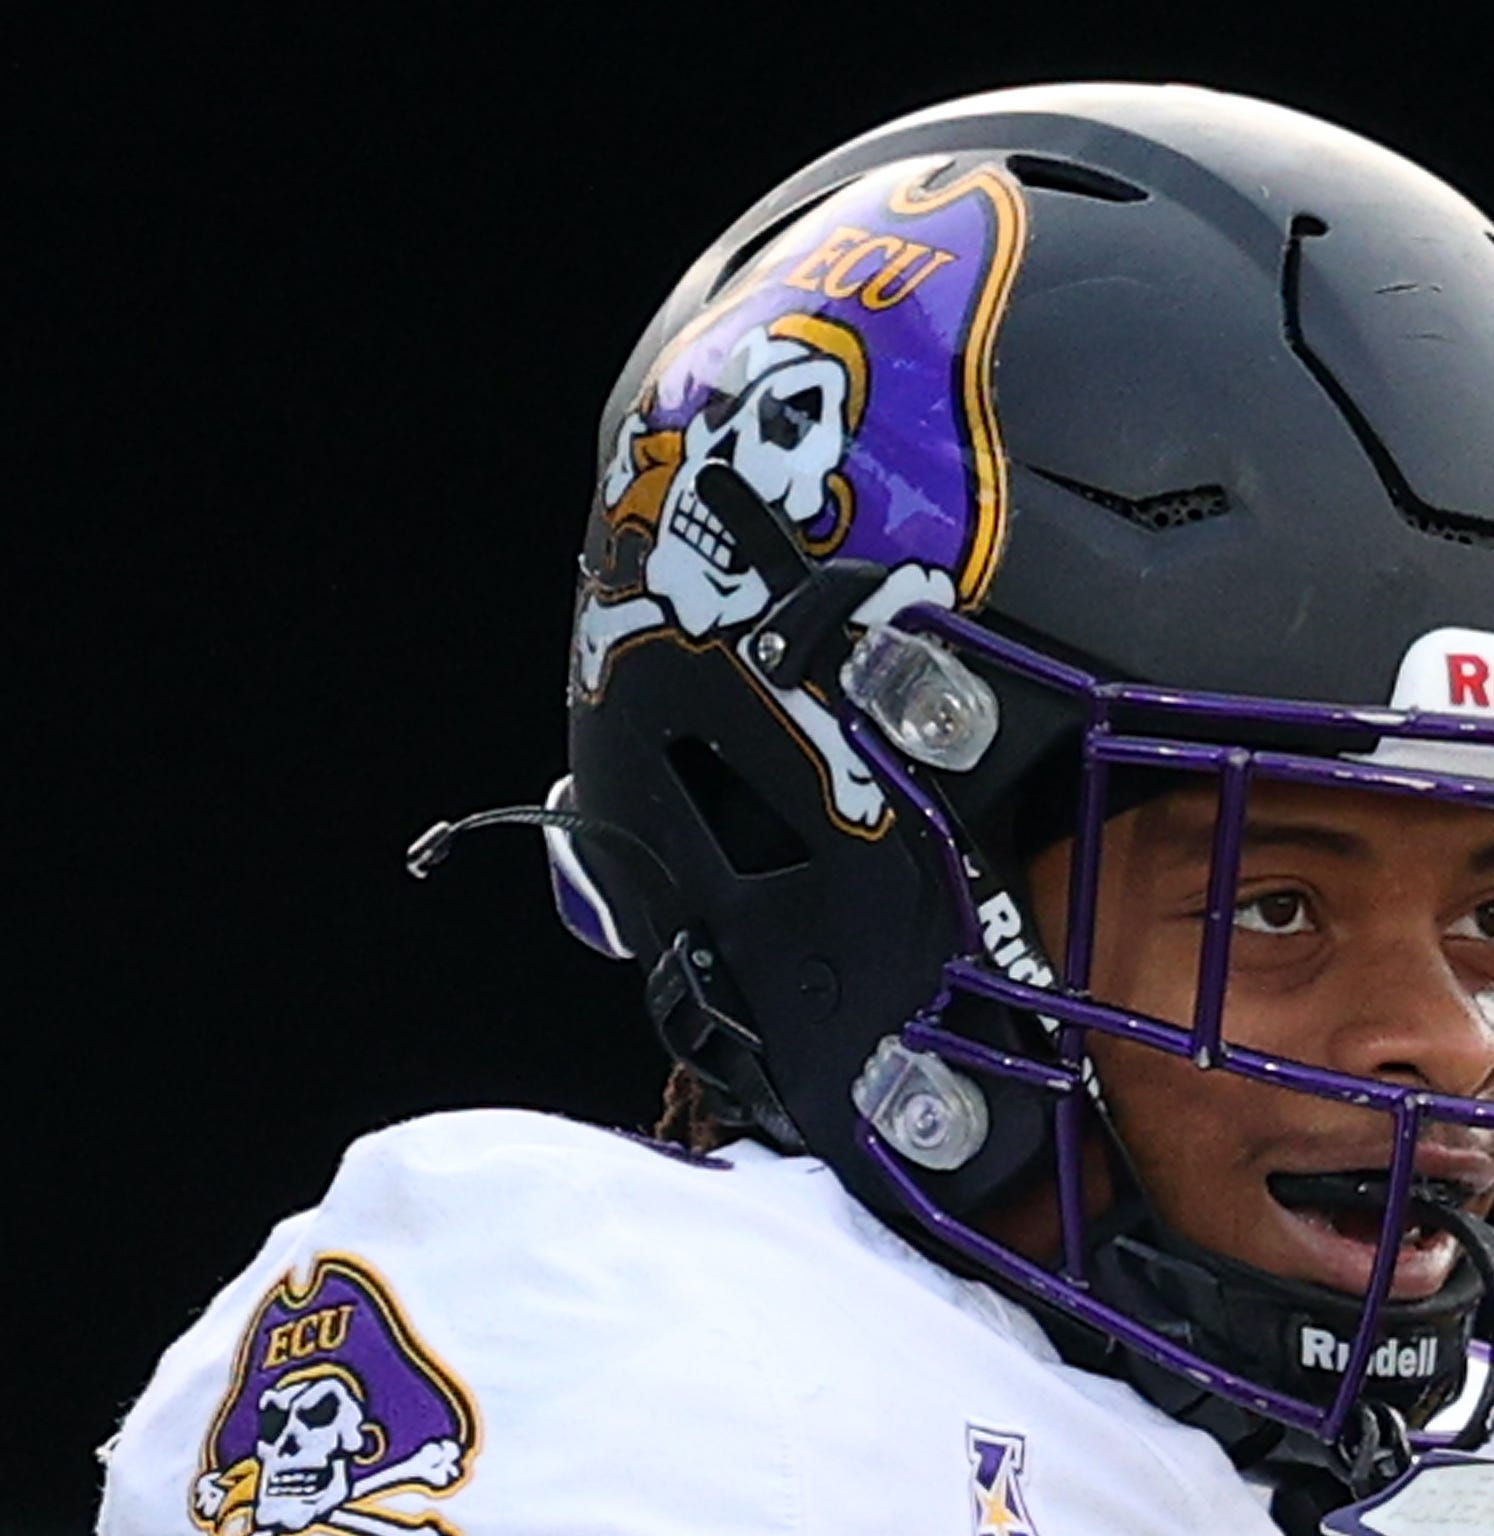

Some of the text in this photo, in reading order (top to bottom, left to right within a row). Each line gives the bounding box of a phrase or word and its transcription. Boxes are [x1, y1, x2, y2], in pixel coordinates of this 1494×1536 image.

[782, 225, 961, 313] ECU
[262, 1303, 354, 1371] ECU
[1301, 1326, 1438, 1378] Ridell
